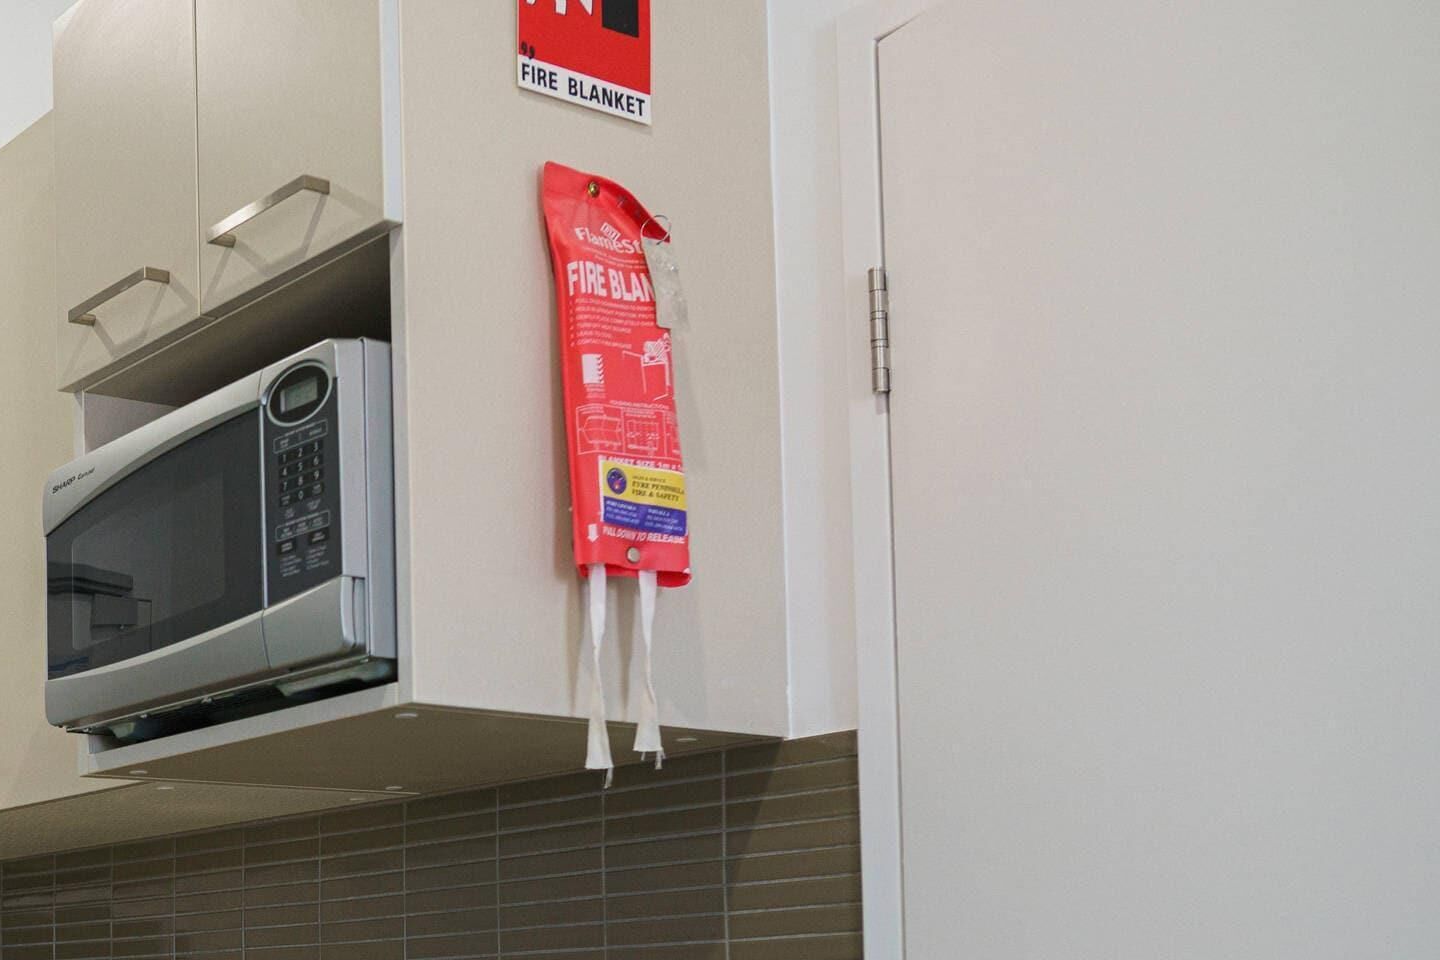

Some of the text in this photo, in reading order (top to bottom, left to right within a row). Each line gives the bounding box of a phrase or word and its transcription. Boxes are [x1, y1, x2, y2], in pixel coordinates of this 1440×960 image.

[521, 63, 645, 116] FIRE BLANKET
[575, 227, 643, 254] FlameSt
[566, 260, 655, 302] FIRE BLAN
